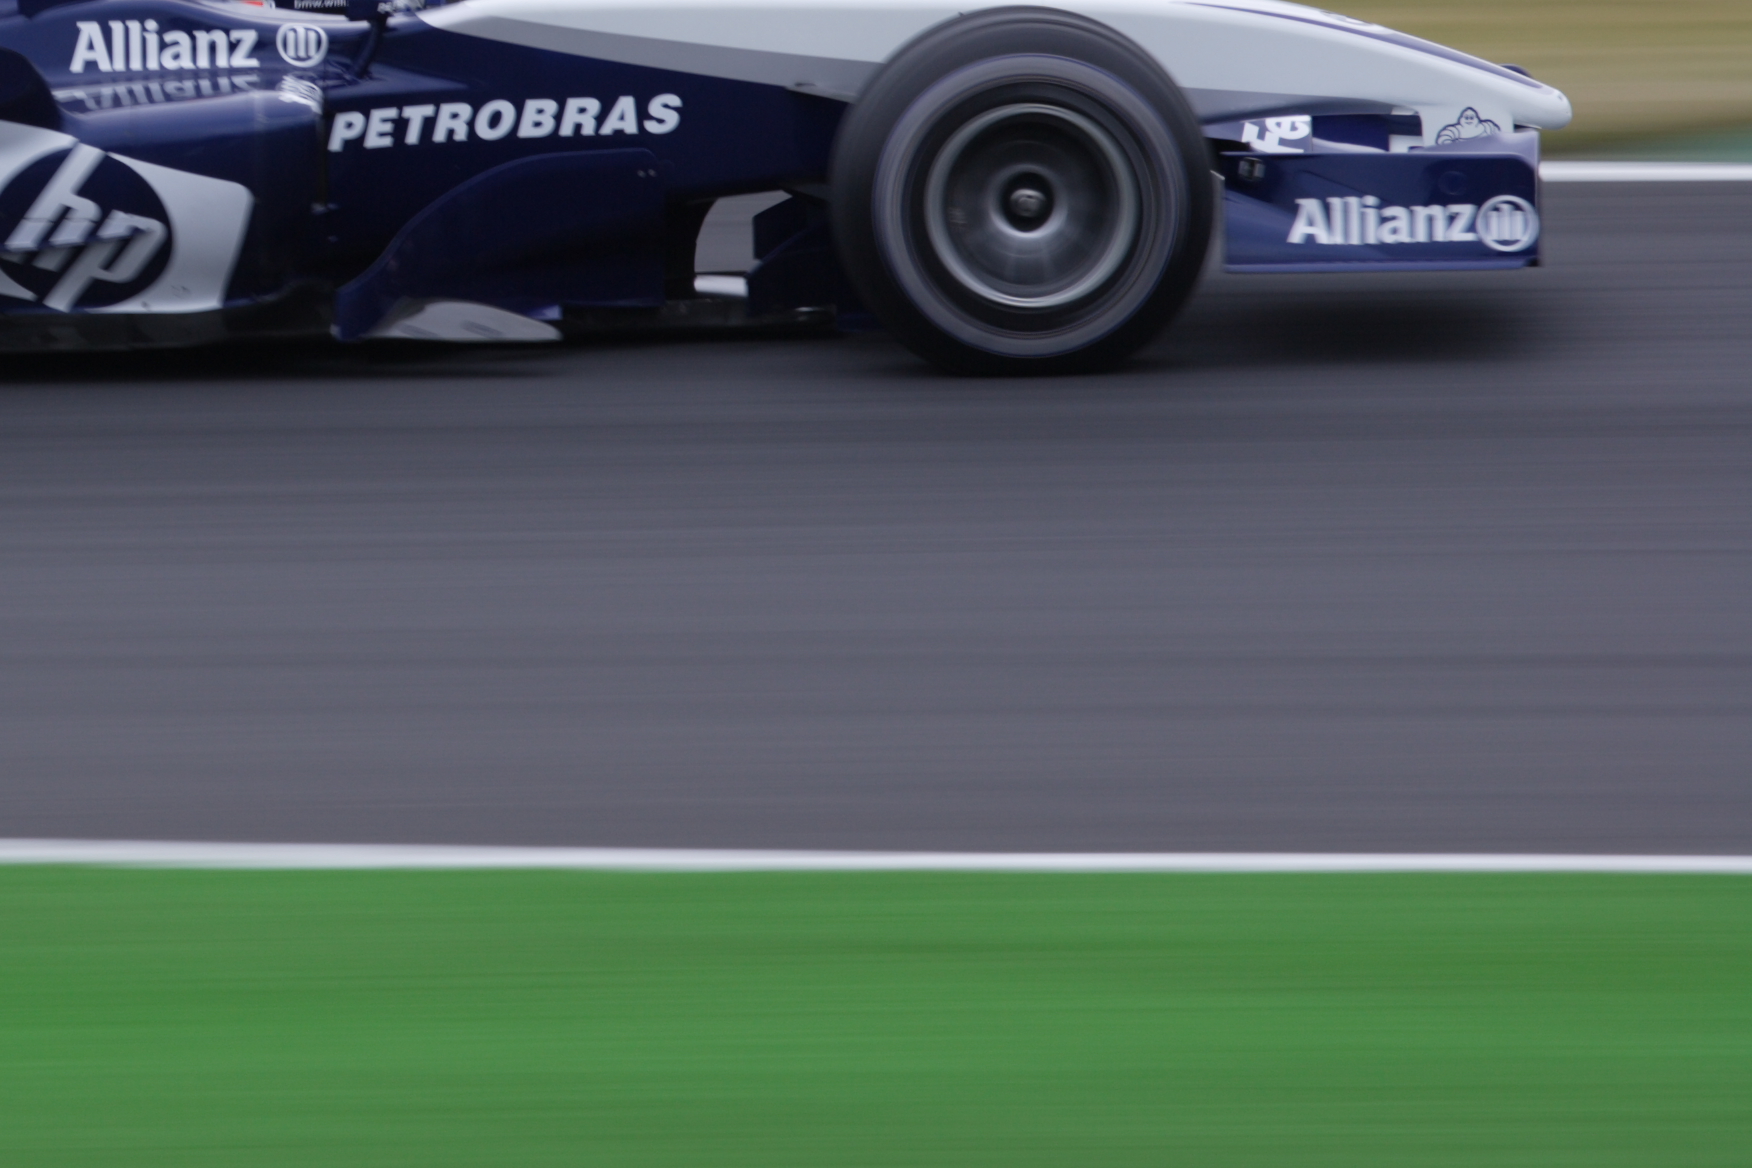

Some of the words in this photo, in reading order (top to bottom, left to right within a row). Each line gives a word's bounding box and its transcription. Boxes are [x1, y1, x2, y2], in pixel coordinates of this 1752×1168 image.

[69, 19, 260, 72] Allianz
[327, 93, 683, 153] PETROBRAS
[3, 142, 167, 313] hp
[1287, 195, 1480, 245] Allianz
